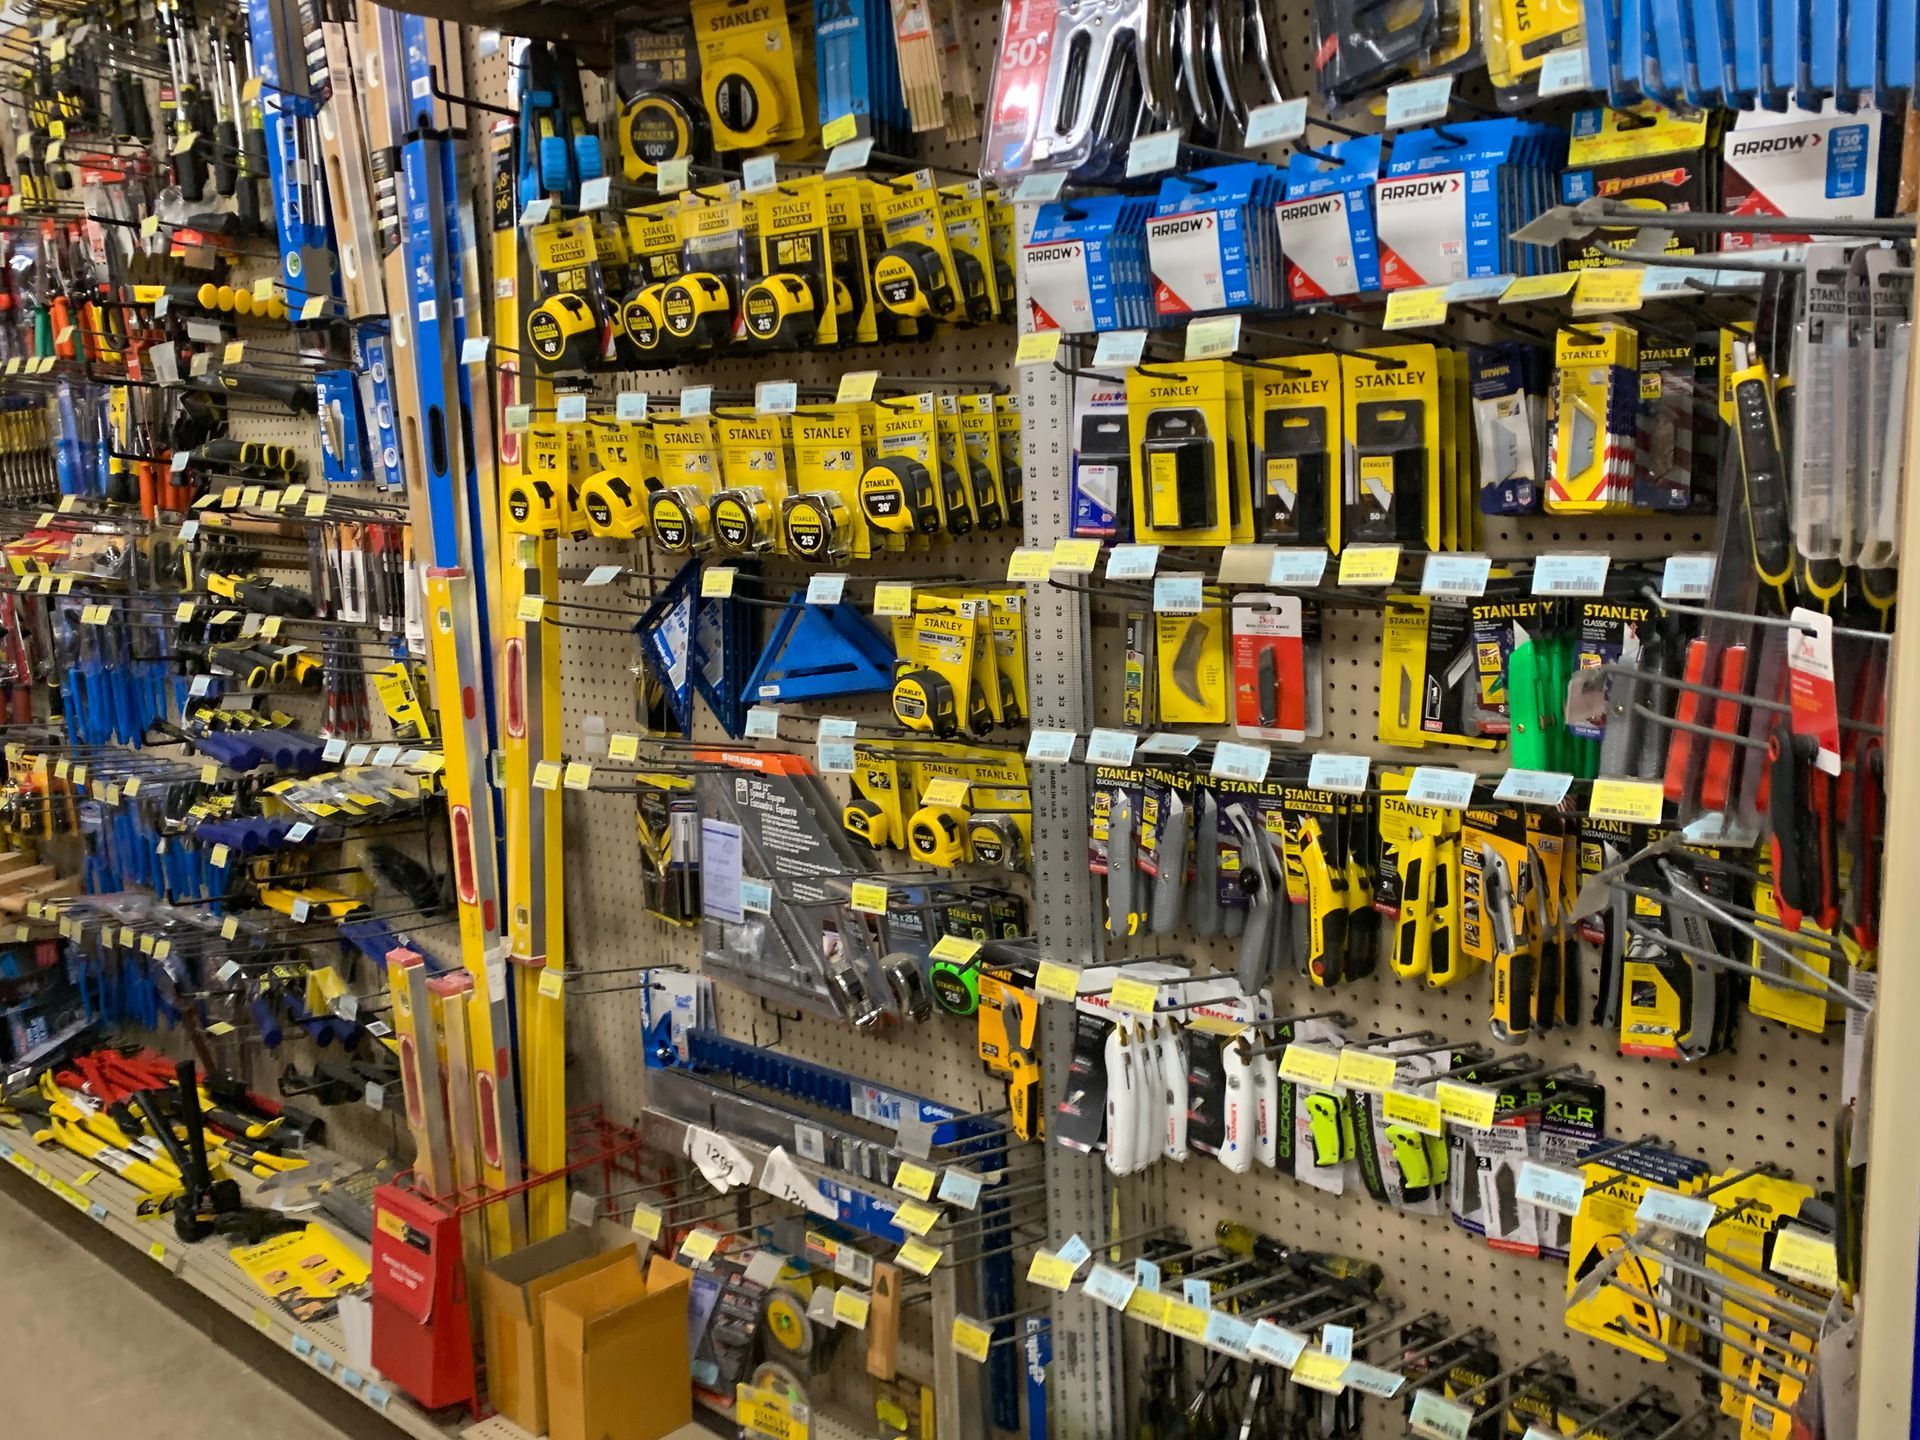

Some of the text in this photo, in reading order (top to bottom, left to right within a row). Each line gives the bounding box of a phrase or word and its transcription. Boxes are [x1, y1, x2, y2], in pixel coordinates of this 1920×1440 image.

[711, 7, 770, 31] STANLEY
[644, 144, 666, 156] 100'
[1733, 134, 1808, 156] ARROW
[1392, 162, 1411, 172] T50
[1471, 170, 1487, 178] T50
[1290, 185, 1304, 195] T50
[1381, 181, 1446, 200] ARROW
[772, 200, 811, 216] STANLEY
[887, 195, 925, 214] STANLEY
[1160, 205, 1175, 213] T50
[698, 209, 728, 221] STANLEY
[1220, 209, 1235, 218] T50
[1282, 201, 1331, 221] ARROW
[699, 219, 729, 230] FATMAX
[774, 214, 812, 228] FATMAX
[642, 224, 674, 237] STANLEY
[1152, 218, 1202, 237] ARROW
[645, 235, 675, 246] FATMAX
[1086, 241, 1100, 250] T50
[550, 239, 584, 254] STANLEY
[552, 250, 585, 263] FATMAX
[1028, 246, 1071, 263] ARROW
[878, 266, 906, 278] STANLEY
[893, 289, 906, 300] 25'
[666, 299, 689, 308] STANLEY
[749, 298, 773, 307] STANLEY
[629, 316, 650, 325] STANLEY
[676, 318, 688, 329] 30'
[758, 317, 772, 330] 25'
[533, 324, 556, 333] STANLEY
[544, 342, 556, 353] 40'
[1561, 350, 1609, 360] STANLEY
[1640, 348, 1691, 360] STANLEY
[1481, 366, 1510, 379] IRWIN
[1355, 371, 1426, 388] STANLEY
[1150, 385, 1199, 397] STANLEY
[1264, 380, 1328, 398] STANLEY
[1642, 385, 1660, 393] USA
[920, 396, 929, 404] 12'
[886, 419, 923, 432] STANLEY
[601, 433, 628, 443] STANLEY
[665, 433, 704, 444] STANLEY
[729, 427, 772, 440] STANLEY
[803, 427, 850, 440] STANLEY
[535, 441, 561, 450] STANLEY
[866, 479, 894, 488] STANLEY
[1505, 490, 1512, 501] 5
[878, 502, 891, 512] 30'
[657, 510, 678, 518] STANLEY
[720, 510, 741, 518] STANLEY
[793, 515, 815, 523] STANLEY
[667, 530, 679, 540] 35'
[728, 529, 740, 540] 30'
[801, 535, 815, 546] 25'
[1006, 597, 1016, 605] 12'
[1472, 602, 1537, 620] STANLEY
[1583, 603, 1649, 621] STANLEY
[924, 618, 962, 631] STANLEY
[1389, 617, 1426, 625] STANLEY
[1583, 619, 1608, 629] CLASSIC
[919, 632, 936, 640] FINGER
[1480, 656, 1499, 665] USA
[898, 687, 922, 696] STANLEY
[904, 705, 916, 715] 16'
[1498, 704, 1504, 713] 3
[722, 753, 763, 767] SWANSON
[922, 763, 958, 775] STANLEY
[976, 768, 1019, 781] STANLEY
[1097, 766, 1143, 782] STANLEY
[1096, 779, 1129, 788] QUICKCHANGE
[1145, 768, 1191, 791] STANLEY
[1220, 781, 1282, 795] STANLEY
[1285, 789, 1333, 803] STANLEY
[1095, 803, 1109, 812] USA
[1289, 802, 1327, 811] FATMAX
[1384, 798, 1438, 820] STANLEY
[1144, 808, 1156, 818] USA
[915, 833, 933, 841] STANLEY
[920, 840, 931, 849] 16'
[1538, 840, 1552, 850] USA
[1583, 854, 1600, 865] USA
[1382, 880, 1388, 889] 3
[947, 907, 983, 922] STANLEY
[936, 980, 965, 993] STANLEY
[1549, 1103, 1593, 1121] XLR
[1229, 1104, 1238, 1142] LENOX
[1546, 1115, 1594, 1129] UTILITY BLADES
[1575, 1130, 1596, 1139] BLADES
[1454, 1137, 1461, 1145] 3
[1546, 1137, 1567, 1146] 75%
[1479, 1158, 1487, 1166] 3
[241, 1236, 305, 1262] STANLEY
